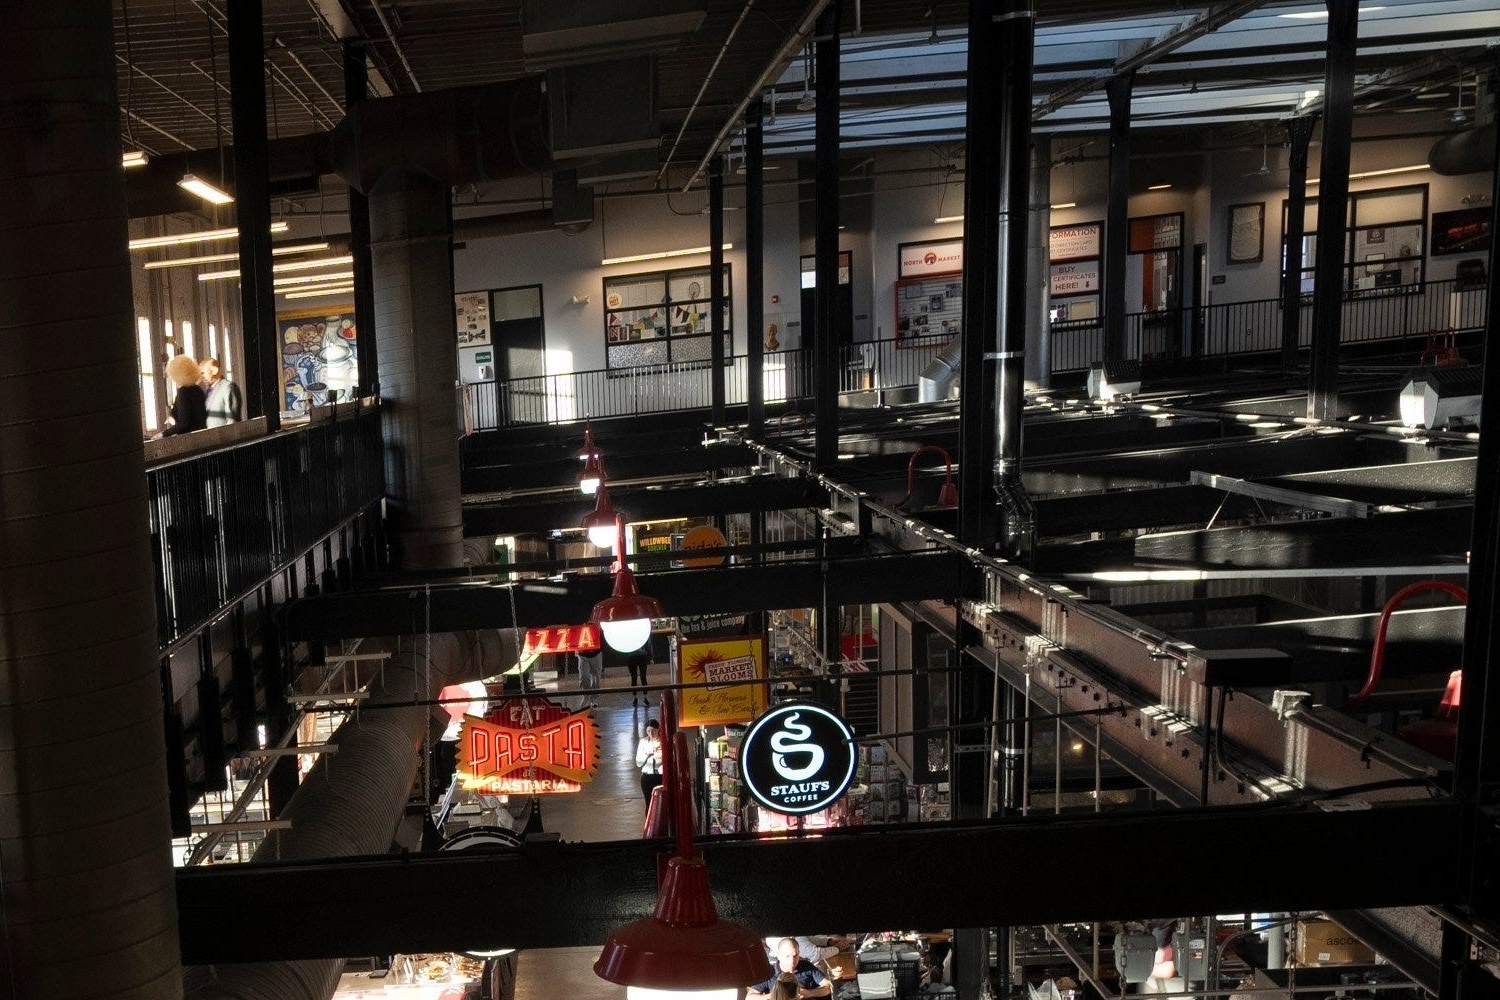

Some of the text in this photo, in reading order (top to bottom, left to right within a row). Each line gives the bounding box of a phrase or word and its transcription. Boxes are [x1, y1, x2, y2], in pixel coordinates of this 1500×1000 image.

[1051, 228, 1096, 240] ORMATION
[1058, 265, 1076, 274] BUY
[1053, 273, 1096, 282] CERTIFICATES
[1055, 282, 1079, 291] HERE!
[523, 626, 595, 651] IZZA
[709, 662, 752, 677] MARKET
[510, 704, 546, 726] EAT
[469, 720, 587, 780] PASTA
[491, 779, 569, 792] PASTARIA
[784, 793, 819, 803] COFFEE
